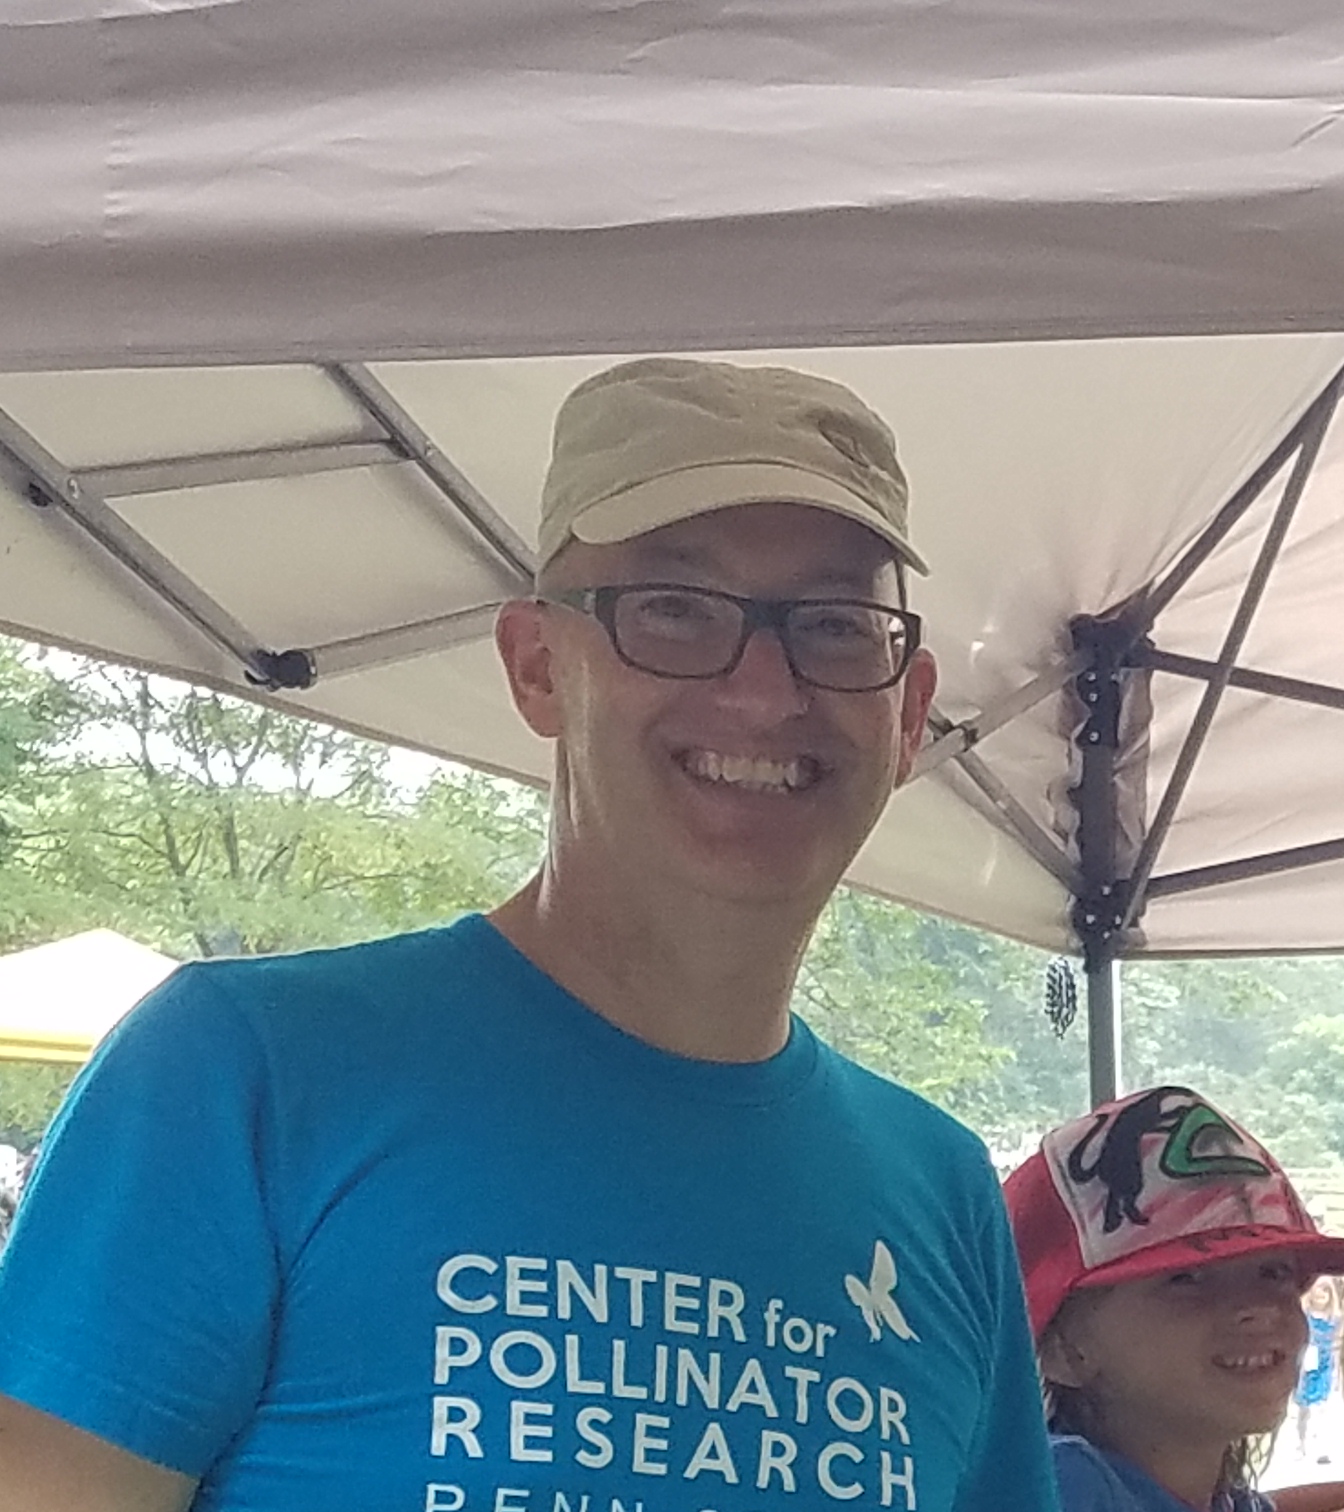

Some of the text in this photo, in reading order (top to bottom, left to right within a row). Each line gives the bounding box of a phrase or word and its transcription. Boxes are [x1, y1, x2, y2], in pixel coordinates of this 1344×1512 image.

[436, 1253, 837, 1357] CENTER for
[433, 1325, 911, 1446] POLLINATOR
[429, 1396, 916, 1511] RESEARCH
